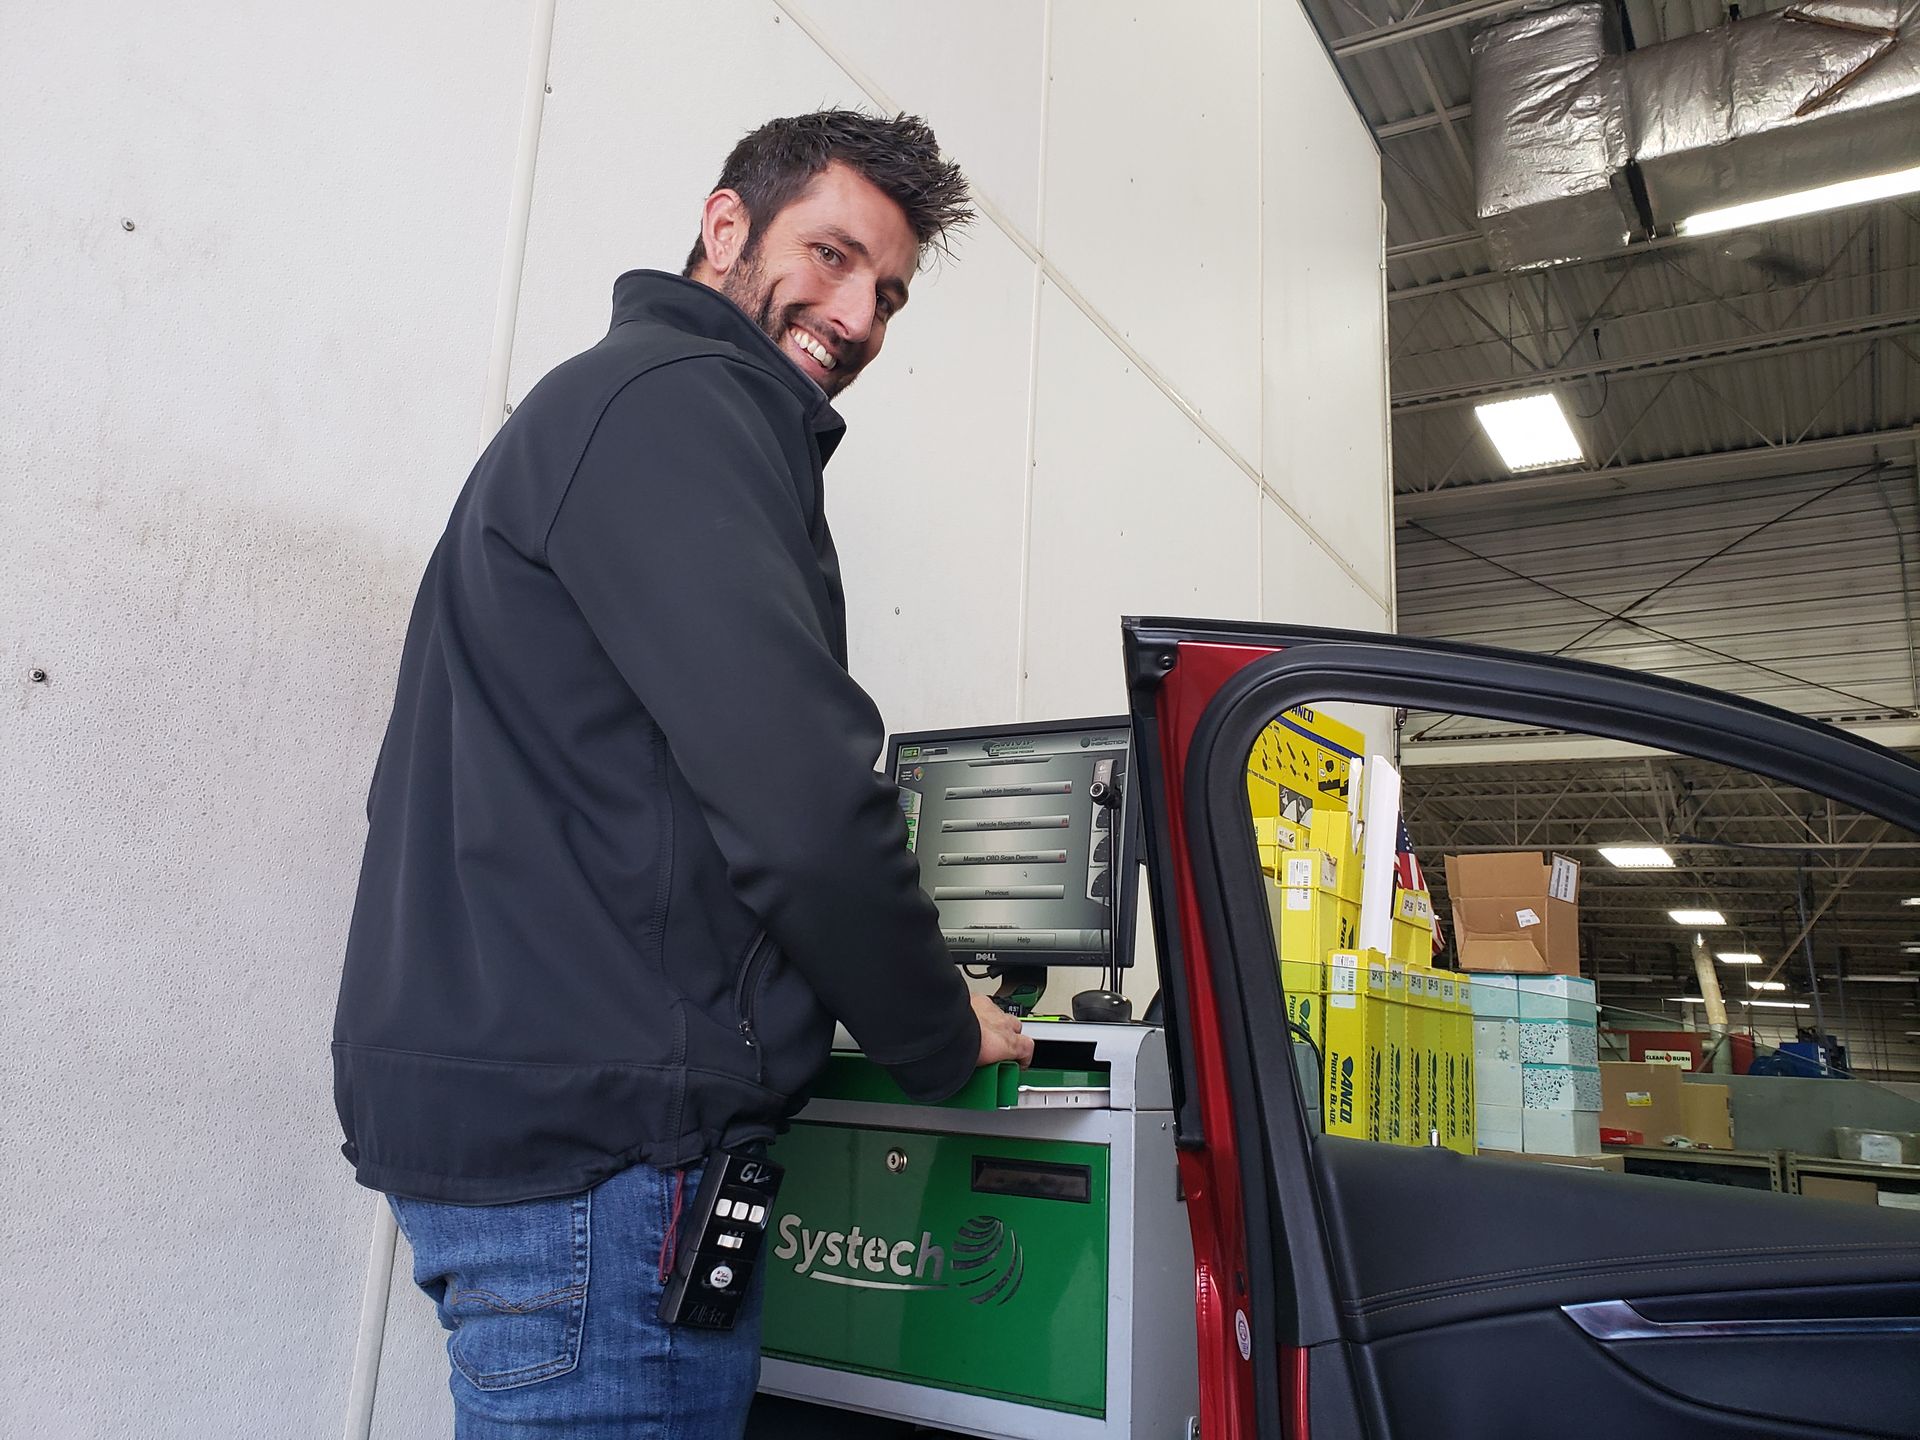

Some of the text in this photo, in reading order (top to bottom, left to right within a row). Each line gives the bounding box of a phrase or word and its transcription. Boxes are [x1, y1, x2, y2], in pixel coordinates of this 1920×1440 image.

[1003, 786, 1032, 794] Inspection
[998, 820, 1032, 828] Registration
[975, 953, 997, 961] DELL
[1329, 1052, 1338, 1126] PROFILE BLADE
[1339, 1073, 1353, 1124] ANCO
[774, 1214, 945, 1281] Systech
